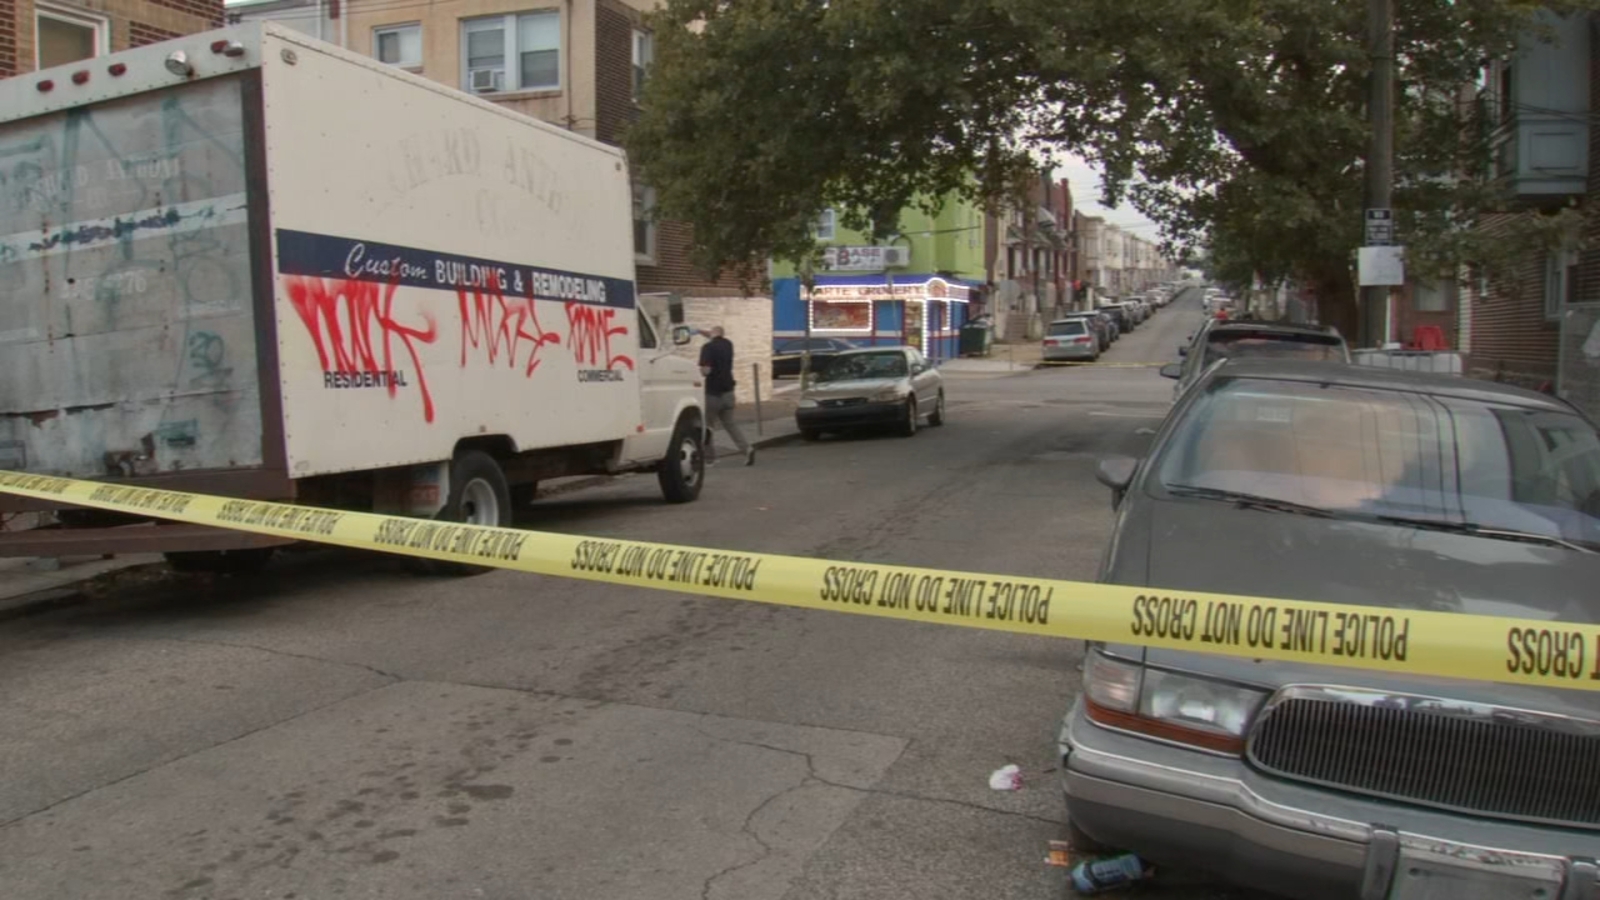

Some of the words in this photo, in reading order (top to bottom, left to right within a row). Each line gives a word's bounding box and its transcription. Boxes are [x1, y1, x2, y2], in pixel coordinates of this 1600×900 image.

[345, 243, 428, 279] Custom
[435, 259, 507, 290] BUILDING
[513, 269, 524, 293] &
[532, 271, 606, 303] REMODELING
[577, 369, 624, 382] COMMERCIAL
[571, 540, 622, 574] CROSS
[616, 545, 652, 578] NOT
[646, 548, 672, 581] DO
[668, 550, 708, 585] LINE
[703, 554, 762, 591] POLICE
[820, 566, 879, 605] CROSS
[877, 571, 917, 610] NOT
[915, 575, 944, 613] DO
[943, 578, 987, 618] LINE
[986, 581, 1054, 625] POLICE
[1131, 595, 1197, 641] CROSS
[1200, 601, 1243, 646] NOT
[1246, 604, 1278, 649] DO
[1280, 608, 1329, 654] LINE
[1332, 612, 1409, 662] POLICE
[1506, 627, 1584, 679] CROSS
